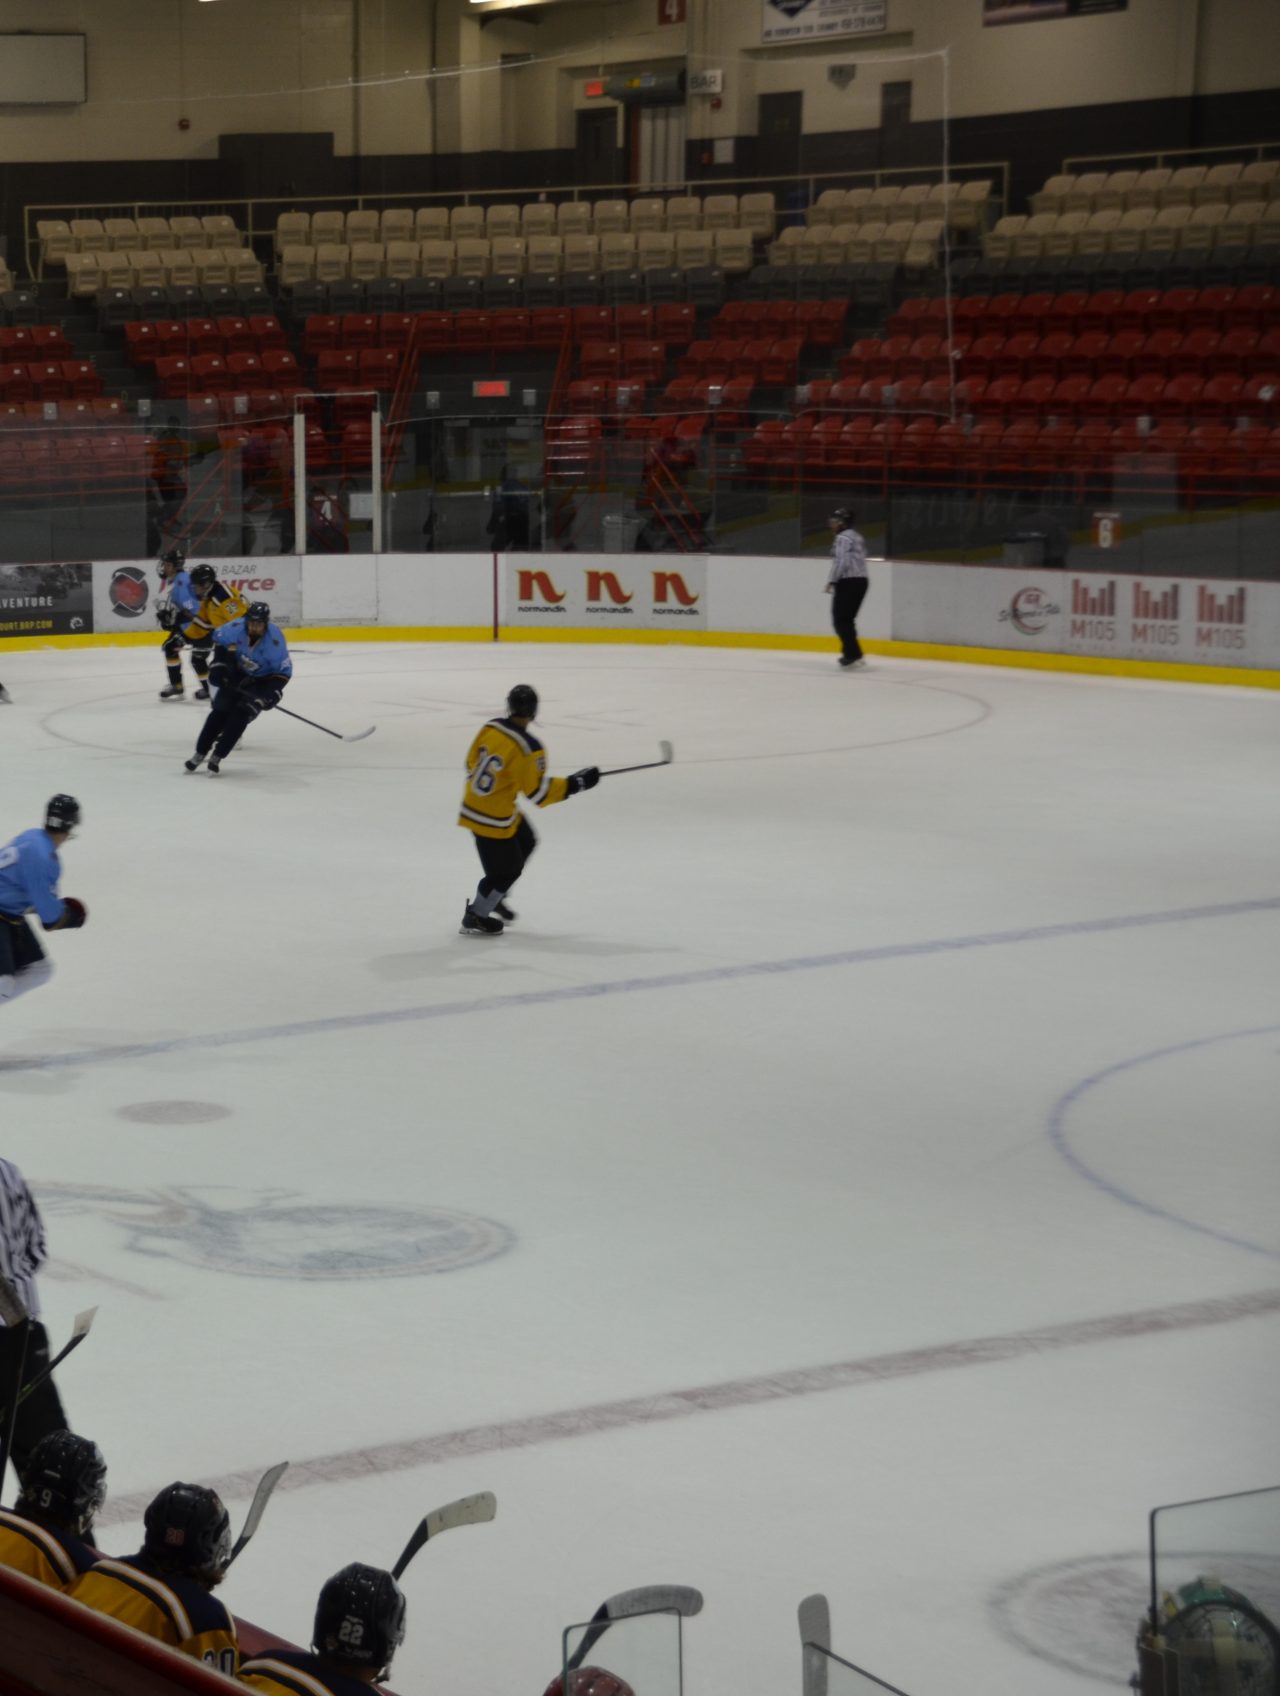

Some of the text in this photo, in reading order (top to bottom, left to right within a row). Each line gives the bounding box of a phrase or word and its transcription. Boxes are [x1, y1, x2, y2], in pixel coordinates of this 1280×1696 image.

[690, 75, 718, 89] BAR
[1098, 518, 1113, 549] 6
[222, 565, 257, 575] BAZAR
[518, 606, 700, 616] normandin normandin normandin
[1071, 620, 1246, 649] M105 M105 M105
[338, 1620, 365, 1646] 22
